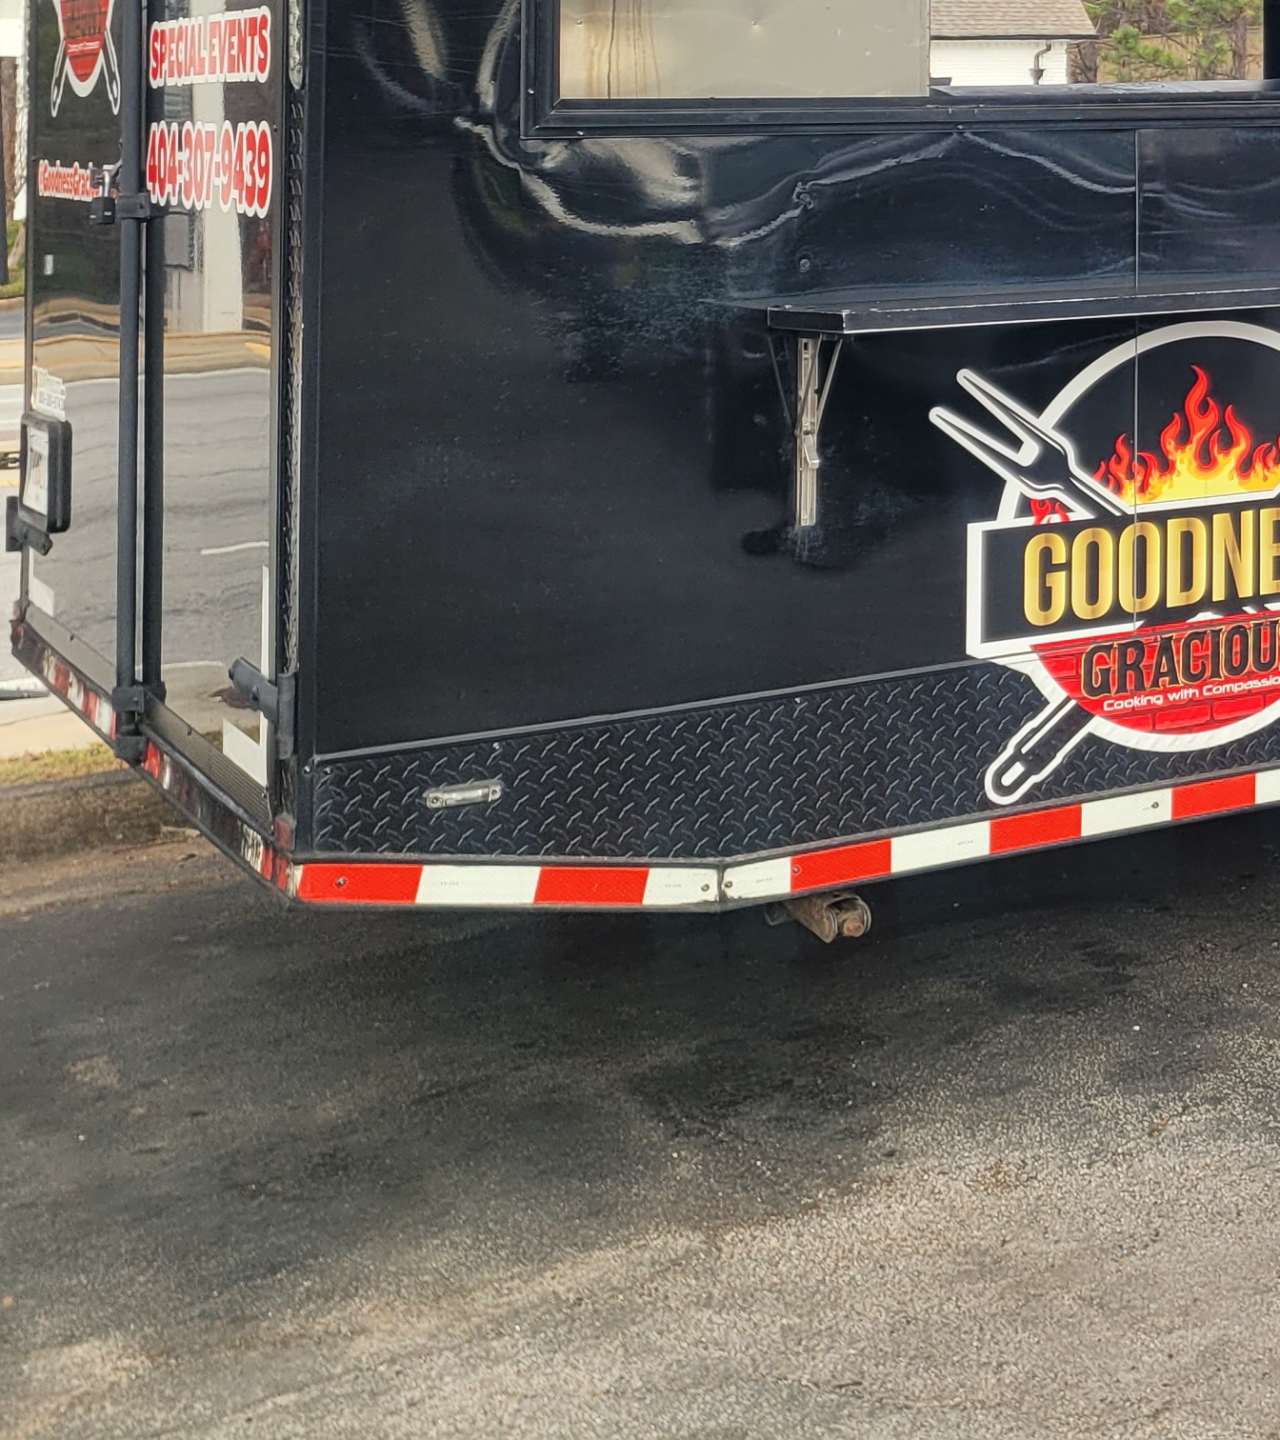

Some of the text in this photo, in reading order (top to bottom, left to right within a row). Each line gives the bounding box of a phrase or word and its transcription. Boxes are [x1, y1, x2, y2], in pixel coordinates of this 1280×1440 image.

[150, 6, 271, 88] SPECIAL EVENTS
[147, 120, 272, 218] 404-307-9439
[1103, 691, 1164, 711] Cooking
[1168, 687, 1199, 702] with
